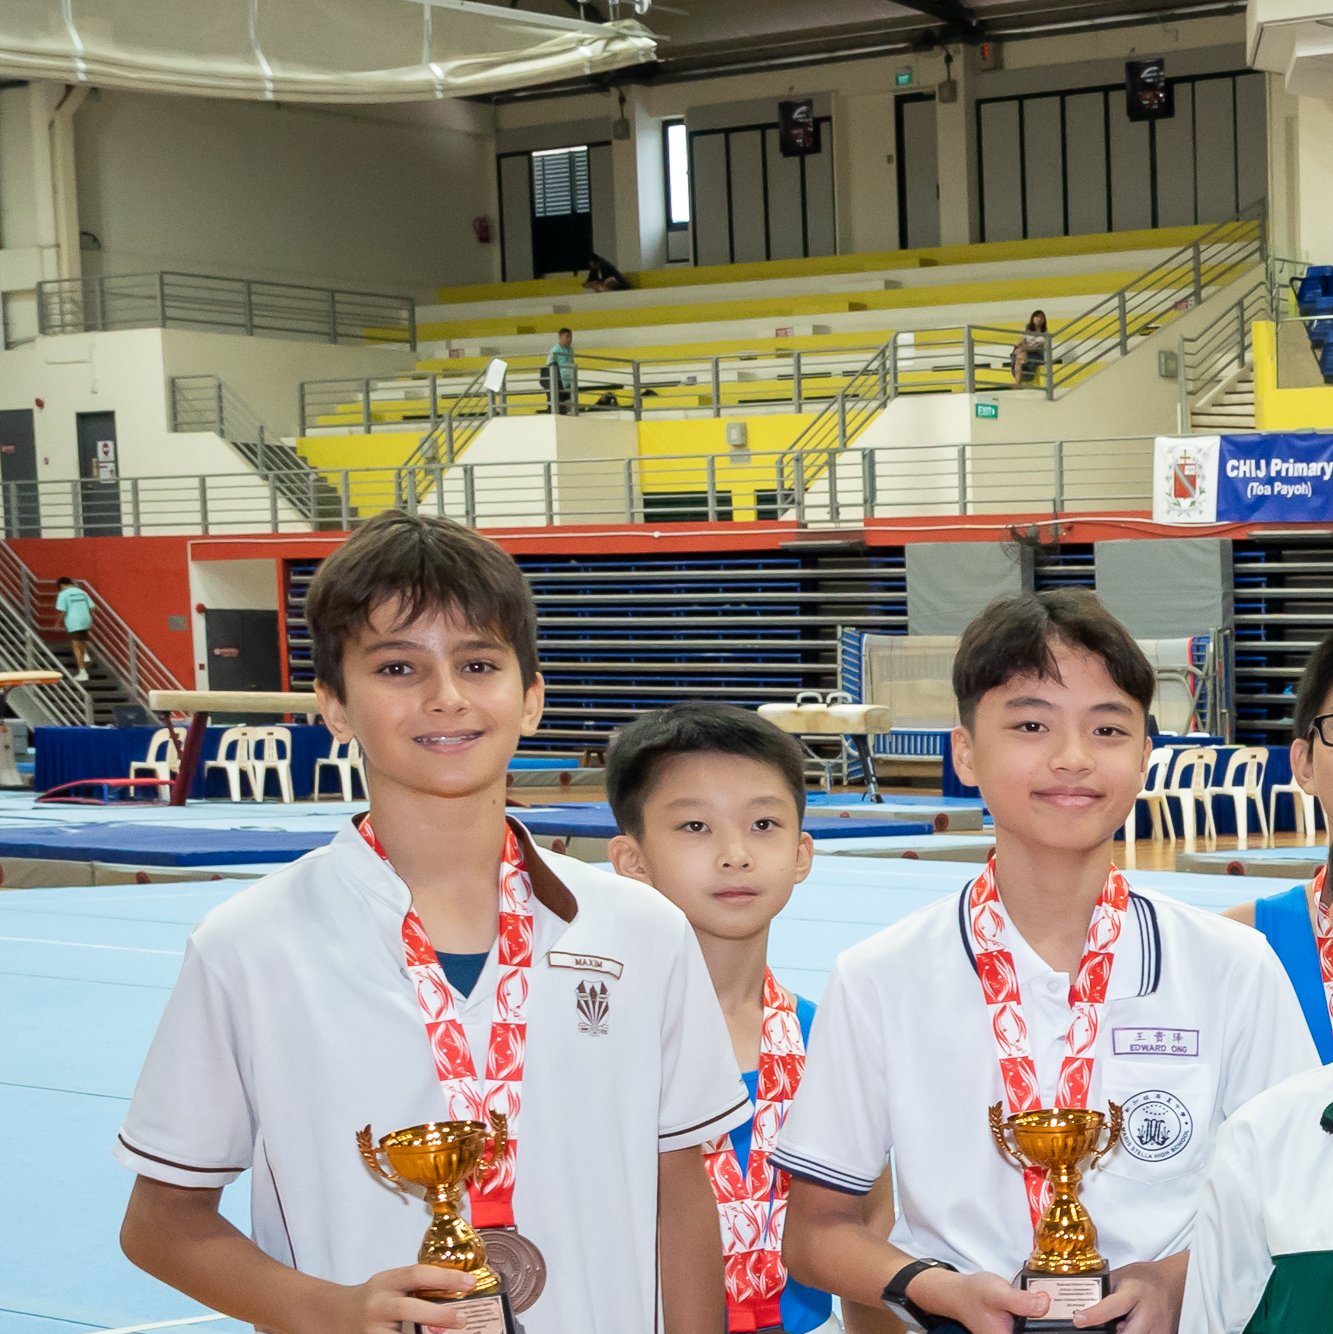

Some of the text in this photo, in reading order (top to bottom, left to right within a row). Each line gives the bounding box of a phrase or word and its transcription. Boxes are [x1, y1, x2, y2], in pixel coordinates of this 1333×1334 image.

[1226, 458, 1267, 478] CHIJ
[1247, 482, 1313, 499] (Toa Payoh)
[575, 958, 603, 968] MAXIM
[1129, 1044, 1188, 1053] EDWARD ONG
